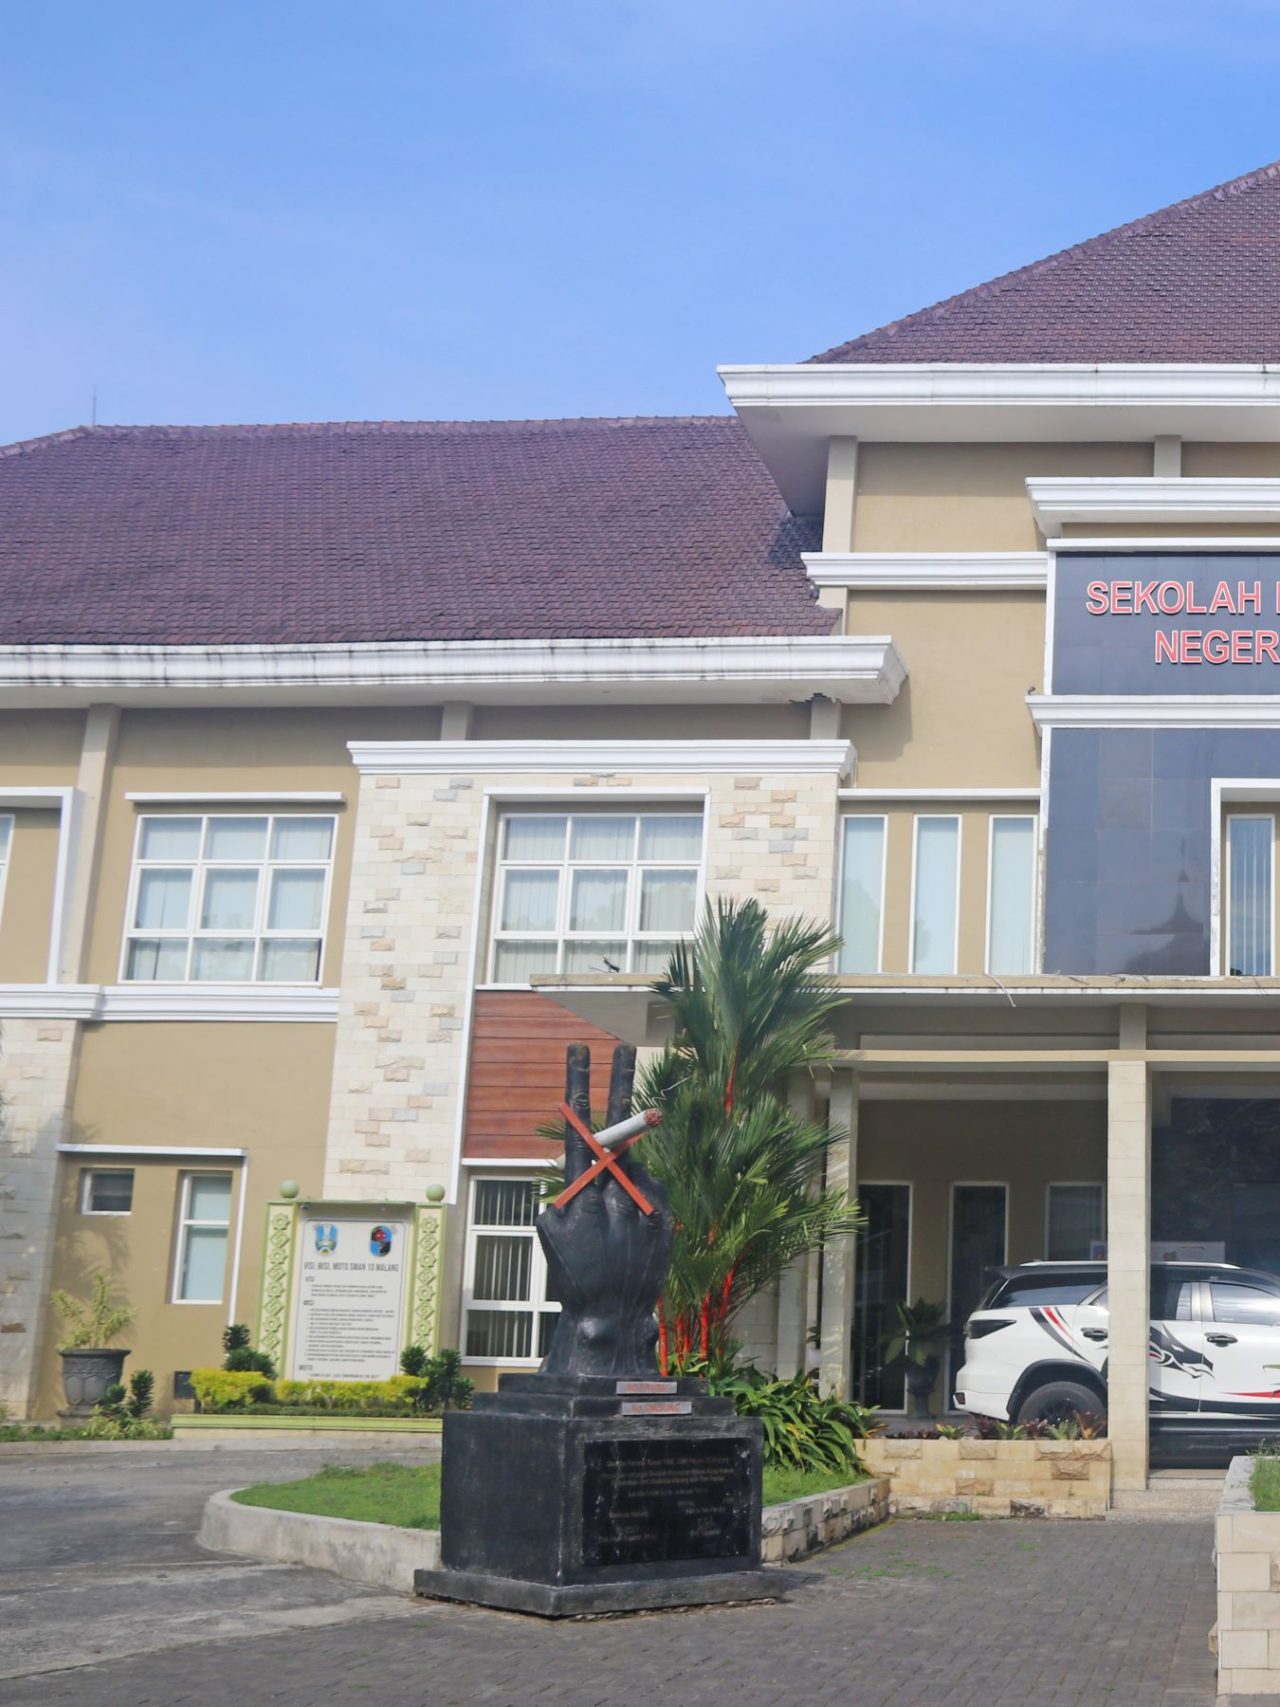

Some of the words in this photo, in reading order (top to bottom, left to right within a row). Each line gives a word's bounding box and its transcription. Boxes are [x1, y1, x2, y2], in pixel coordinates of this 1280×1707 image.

[1085, 580, 1261, 616] SEKOLAH
[350, 1263, 366, 1271] SMAN
[376, 1263, 399, 1272] MALANG
